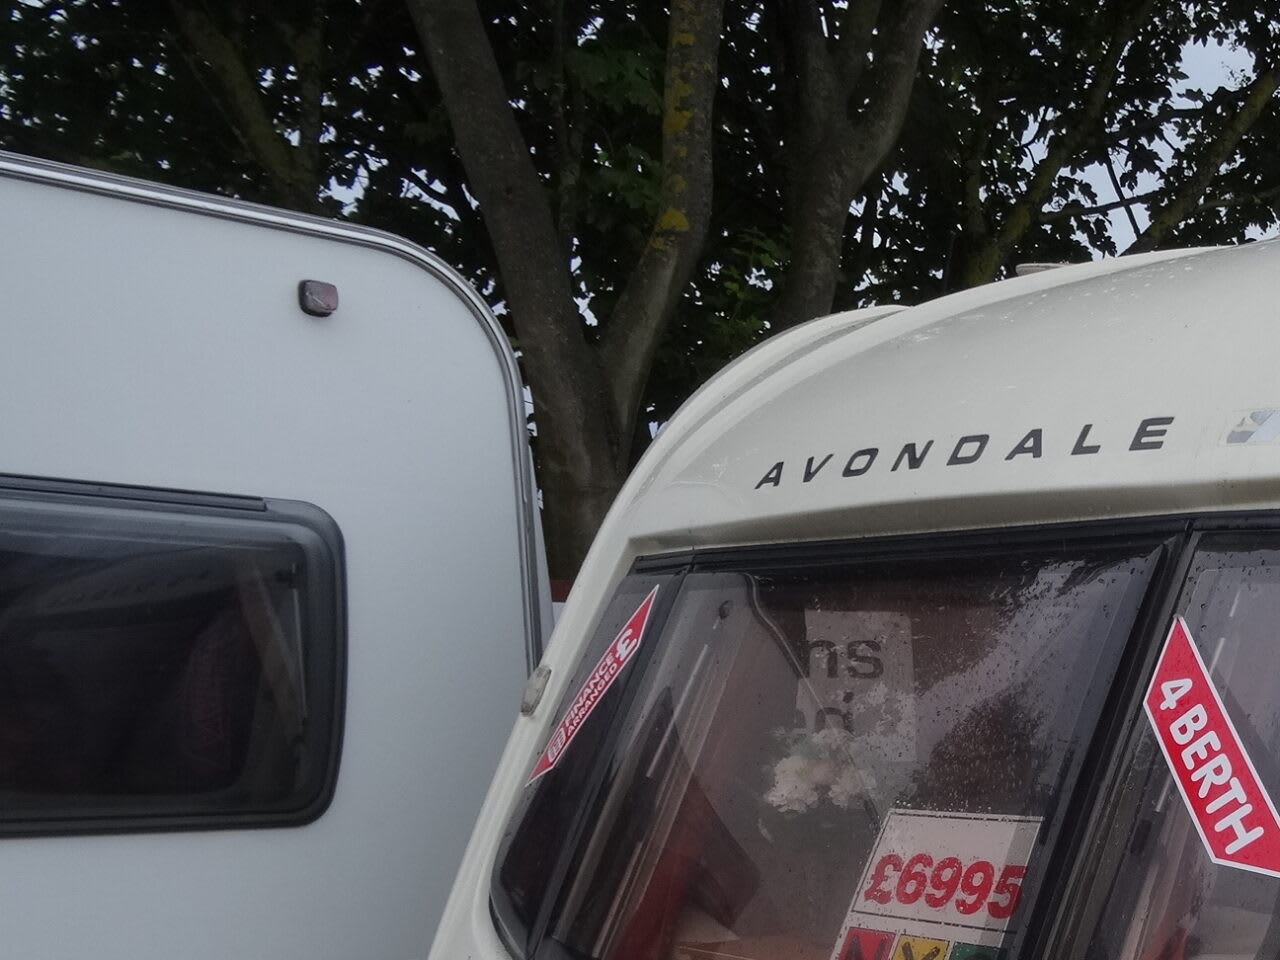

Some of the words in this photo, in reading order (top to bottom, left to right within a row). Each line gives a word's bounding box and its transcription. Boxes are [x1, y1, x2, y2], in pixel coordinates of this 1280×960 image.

[755, 416, 1175, 490] AVONDALE
[564, 651, 615, 728] FINANCE
[566, 664, 618, 737] ARRANGED
[1159, 678, 1193, 711] 4
[1169, 703, 1265, 855] BERTH
[863, 853, 1028, 919] £6995
